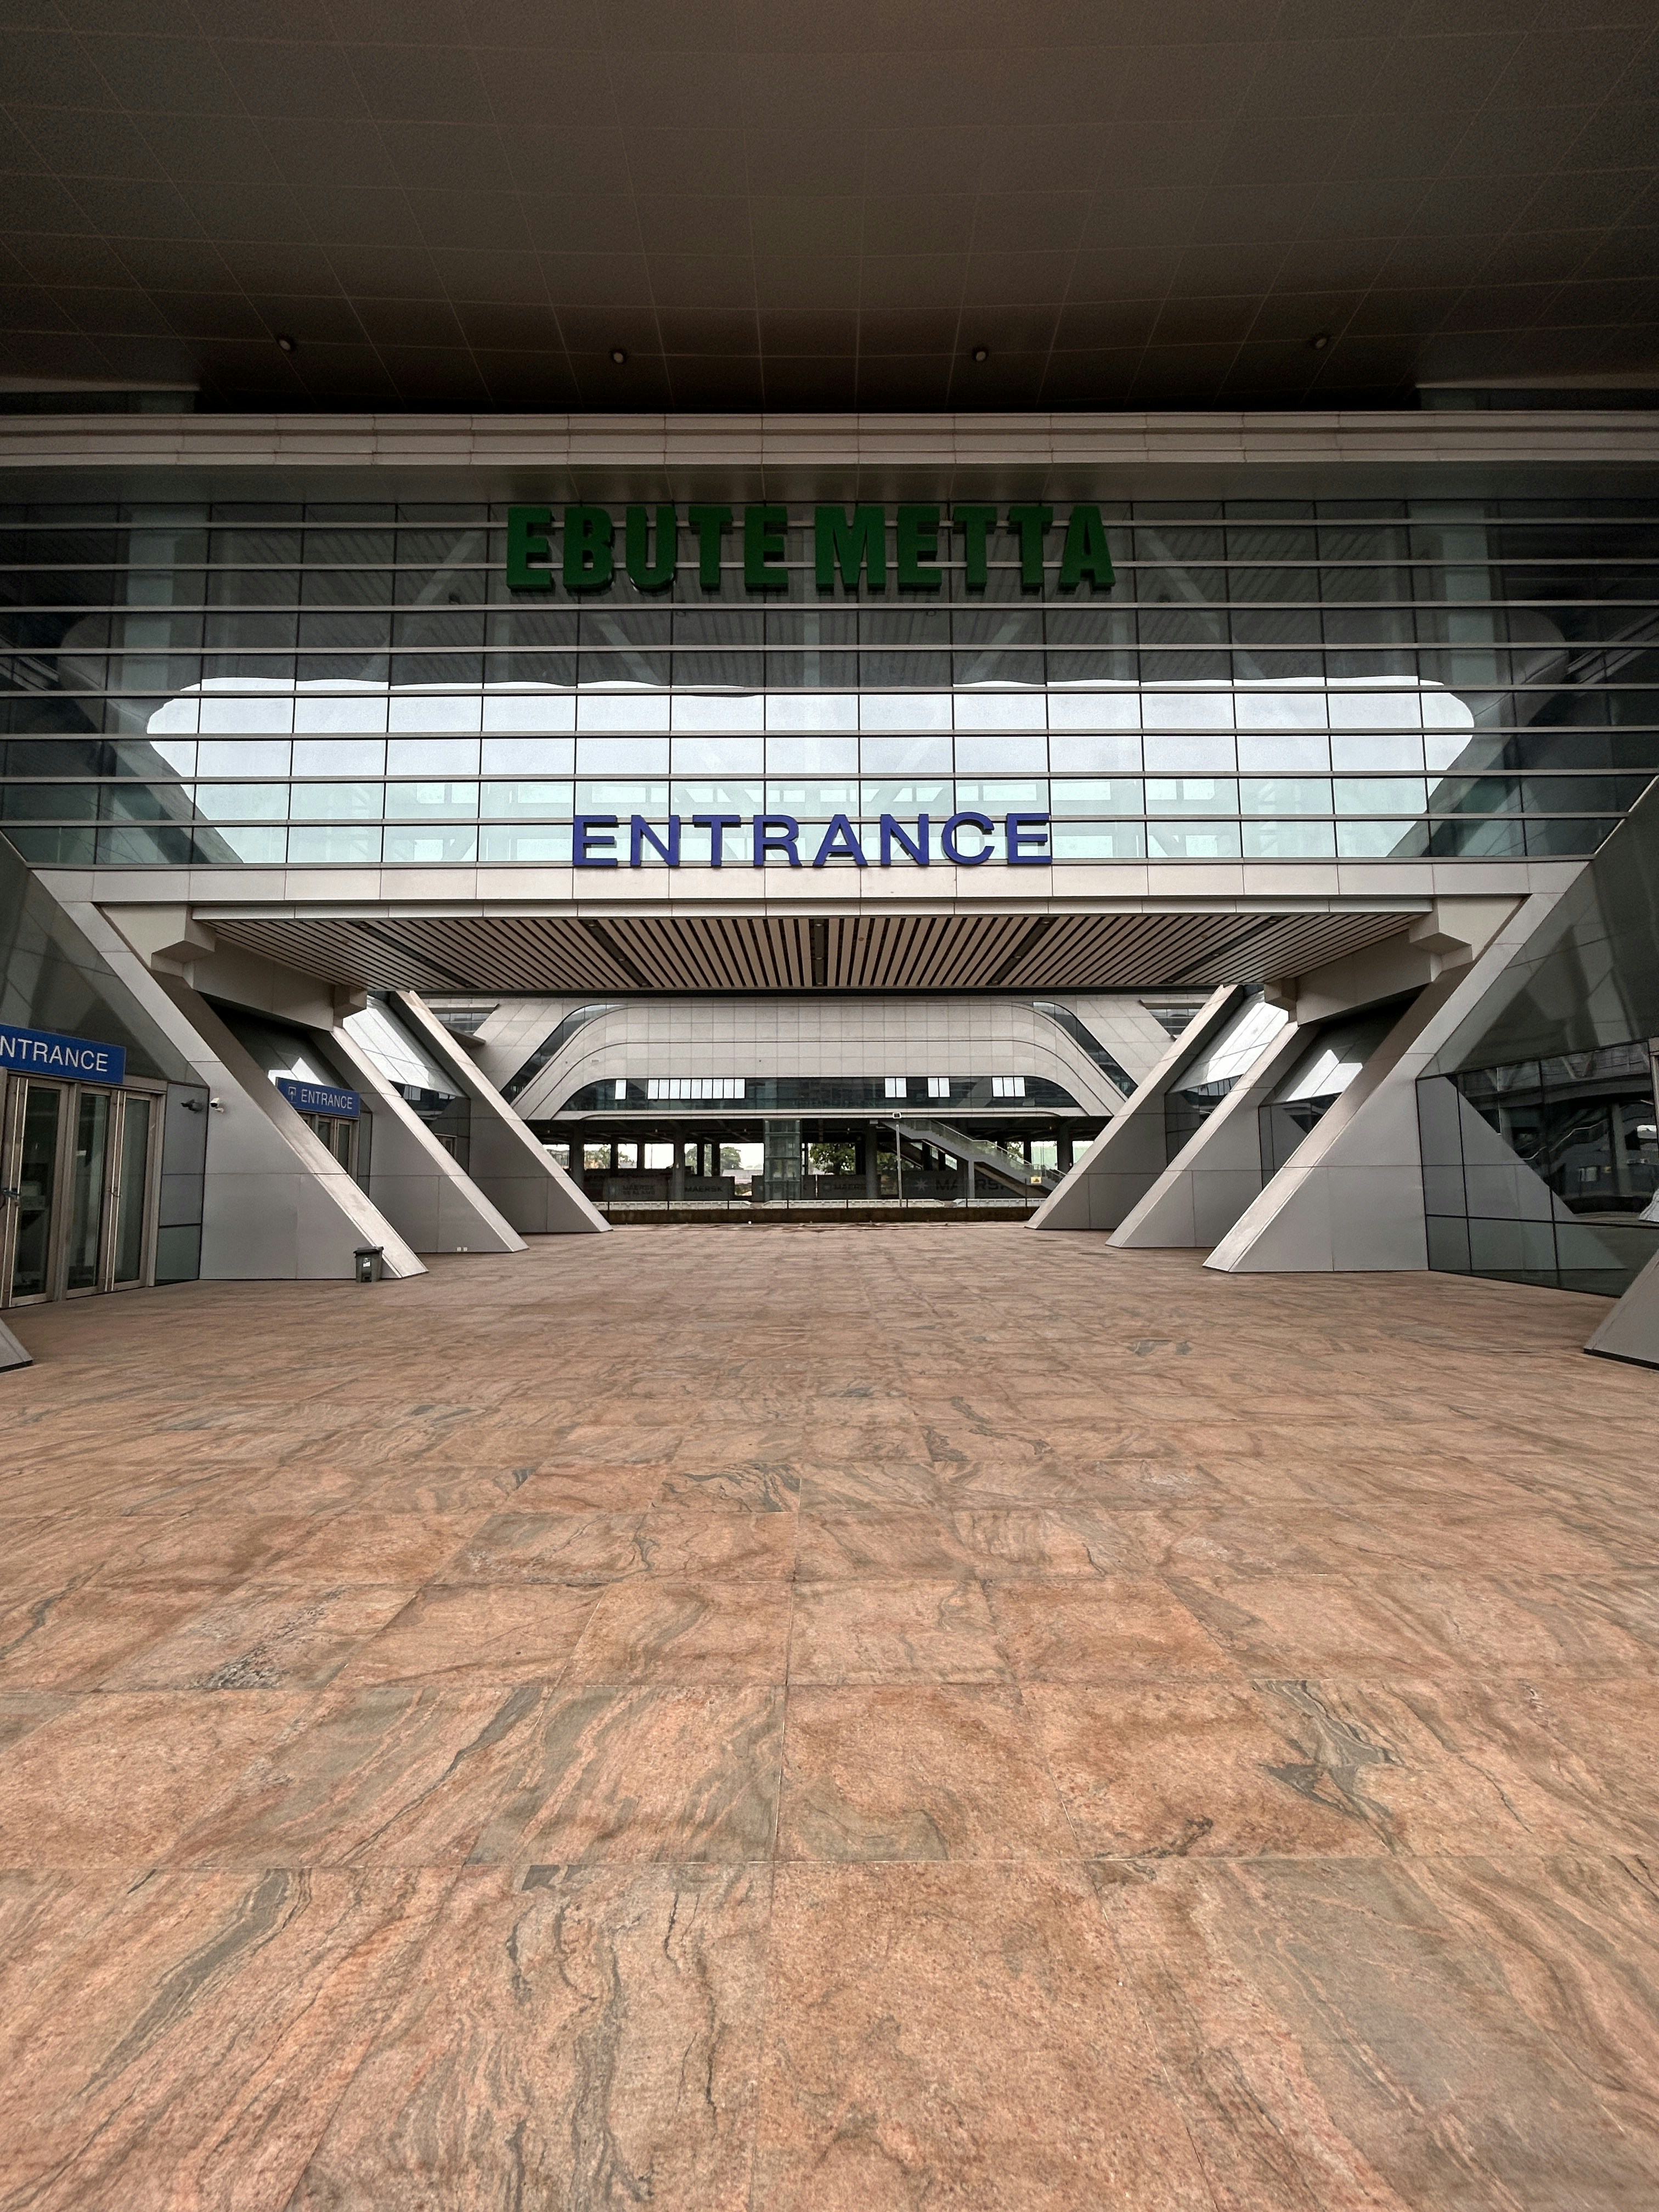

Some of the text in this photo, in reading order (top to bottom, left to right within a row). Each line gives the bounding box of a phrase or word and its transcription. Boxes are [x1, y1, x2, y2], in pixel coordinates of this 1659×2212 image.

[507, 505, 1115, 591] EBUTE METTA
[572, 811, 1052, 867] ENTRANCE
[0, 1035, 109, 1072] NTRANCE
[301, 1088, 353, 1109] ENTRANCE
